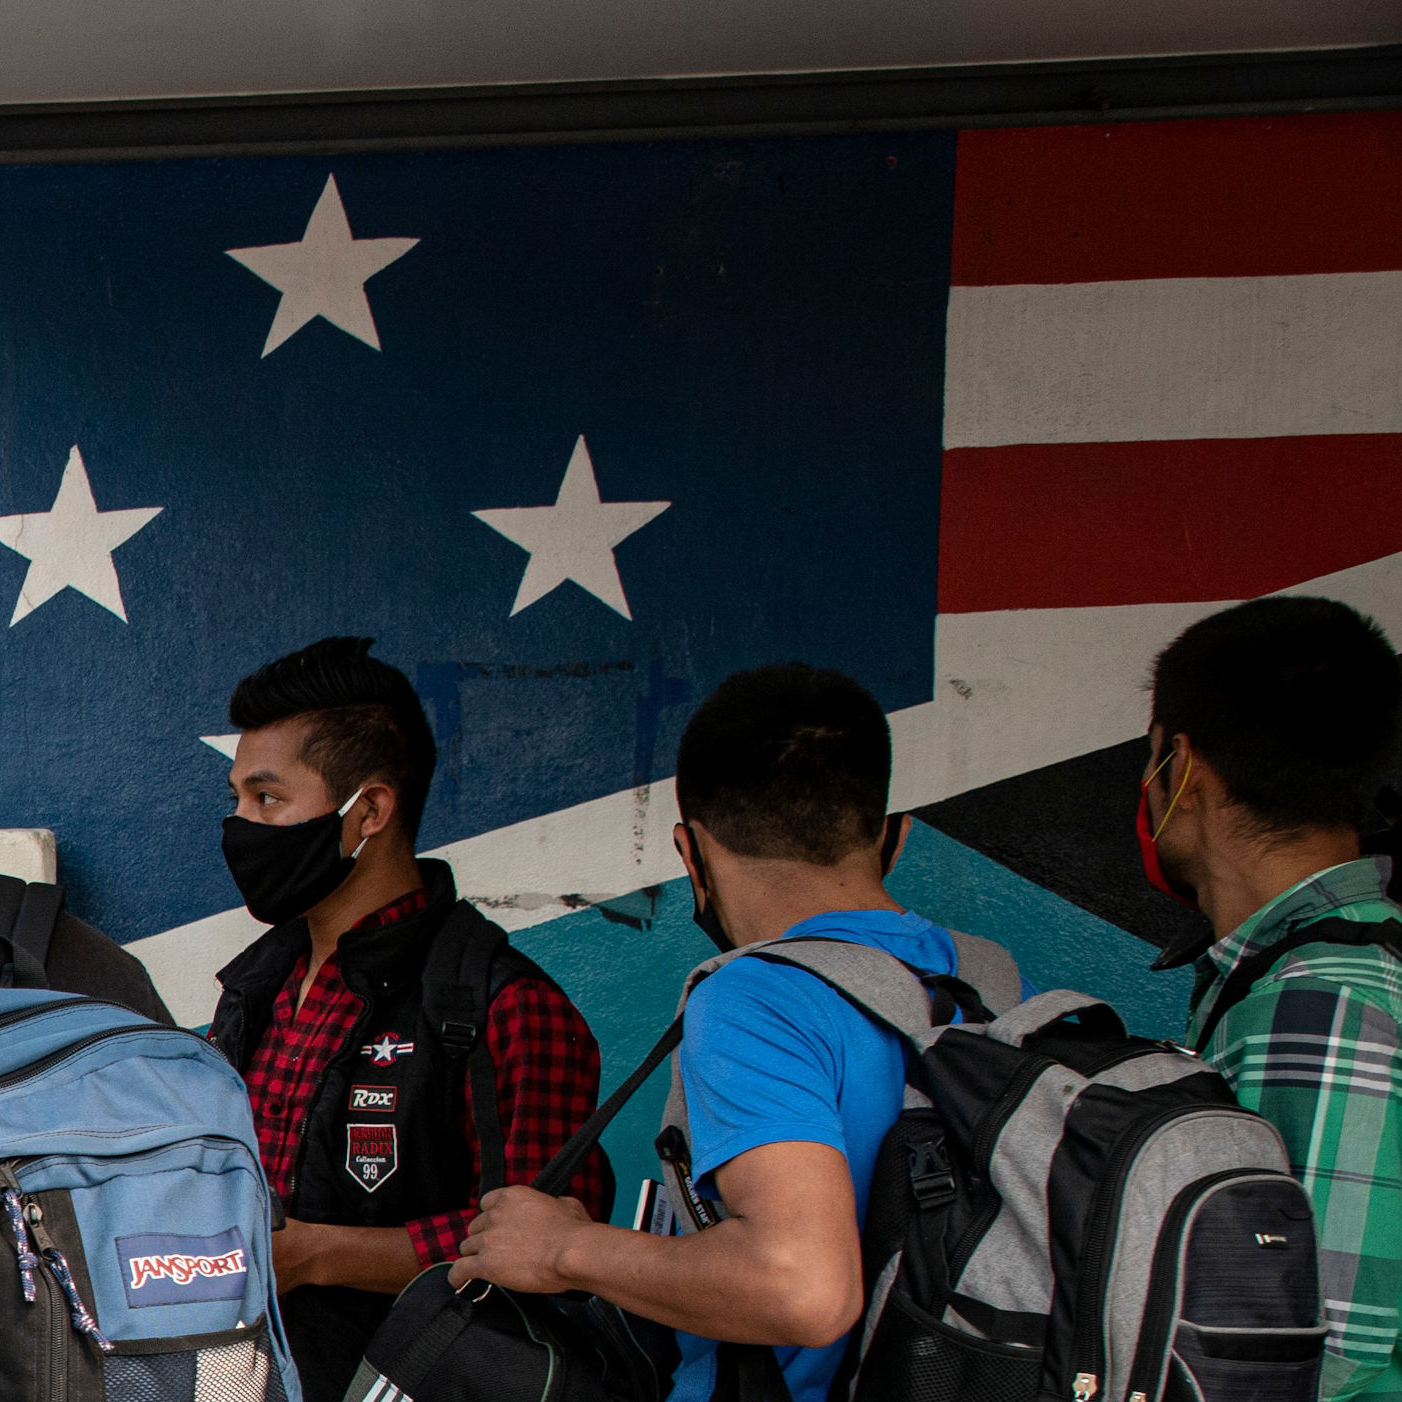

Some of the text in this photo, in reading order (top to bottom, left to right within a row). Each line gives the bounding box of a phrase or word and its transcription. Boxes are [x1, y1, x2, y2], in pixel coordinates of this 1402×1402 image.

[352, 1142, 394, 1155] RADIX
[363, 1163, 378, 1180] 99
[129, 1249, 245, 1290] JANSPORT
